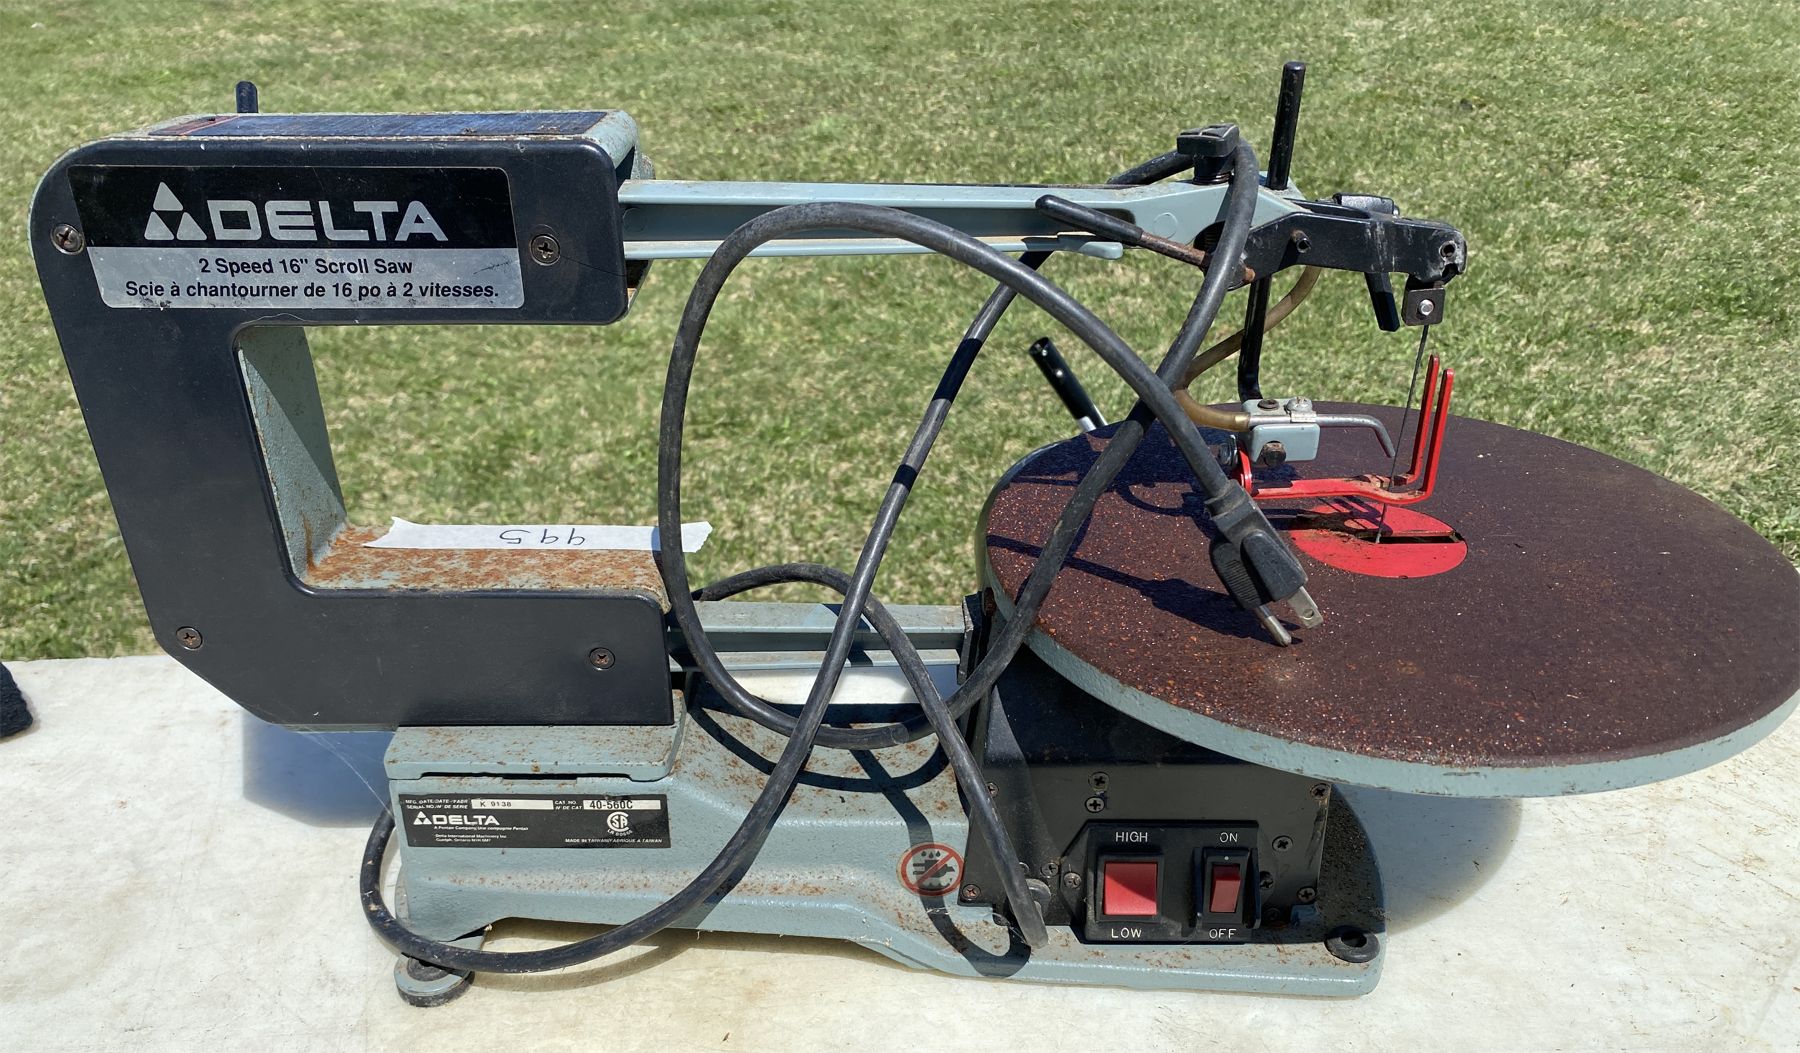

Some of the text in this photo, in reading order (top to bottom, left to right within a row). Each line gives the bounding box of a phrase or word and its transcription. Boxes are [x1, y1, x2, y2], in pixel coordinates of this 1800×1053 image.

[207, 200, 448, 241] DELTA
[199, 258, 210, 274] 2
[216, 258, 273, 277] Speed
[316, 258, 369, 274] Scroll
[375, 258, 413, 274] Saw
[125, 281, 499, 301] Scie à chantourner de 16 po à 2 vitesses.
[499, 527, 586, 546] 995
[589, 800, 633, 809] 40-560C
[432, 815, 500, 825] DELTA
[1115, 831, 1148, 843] HIGH
[1219, 832, 1238, 843] ON
[1111, 927, 1142, 939] LOW
[1209, 928, 1237, 939] OFF
